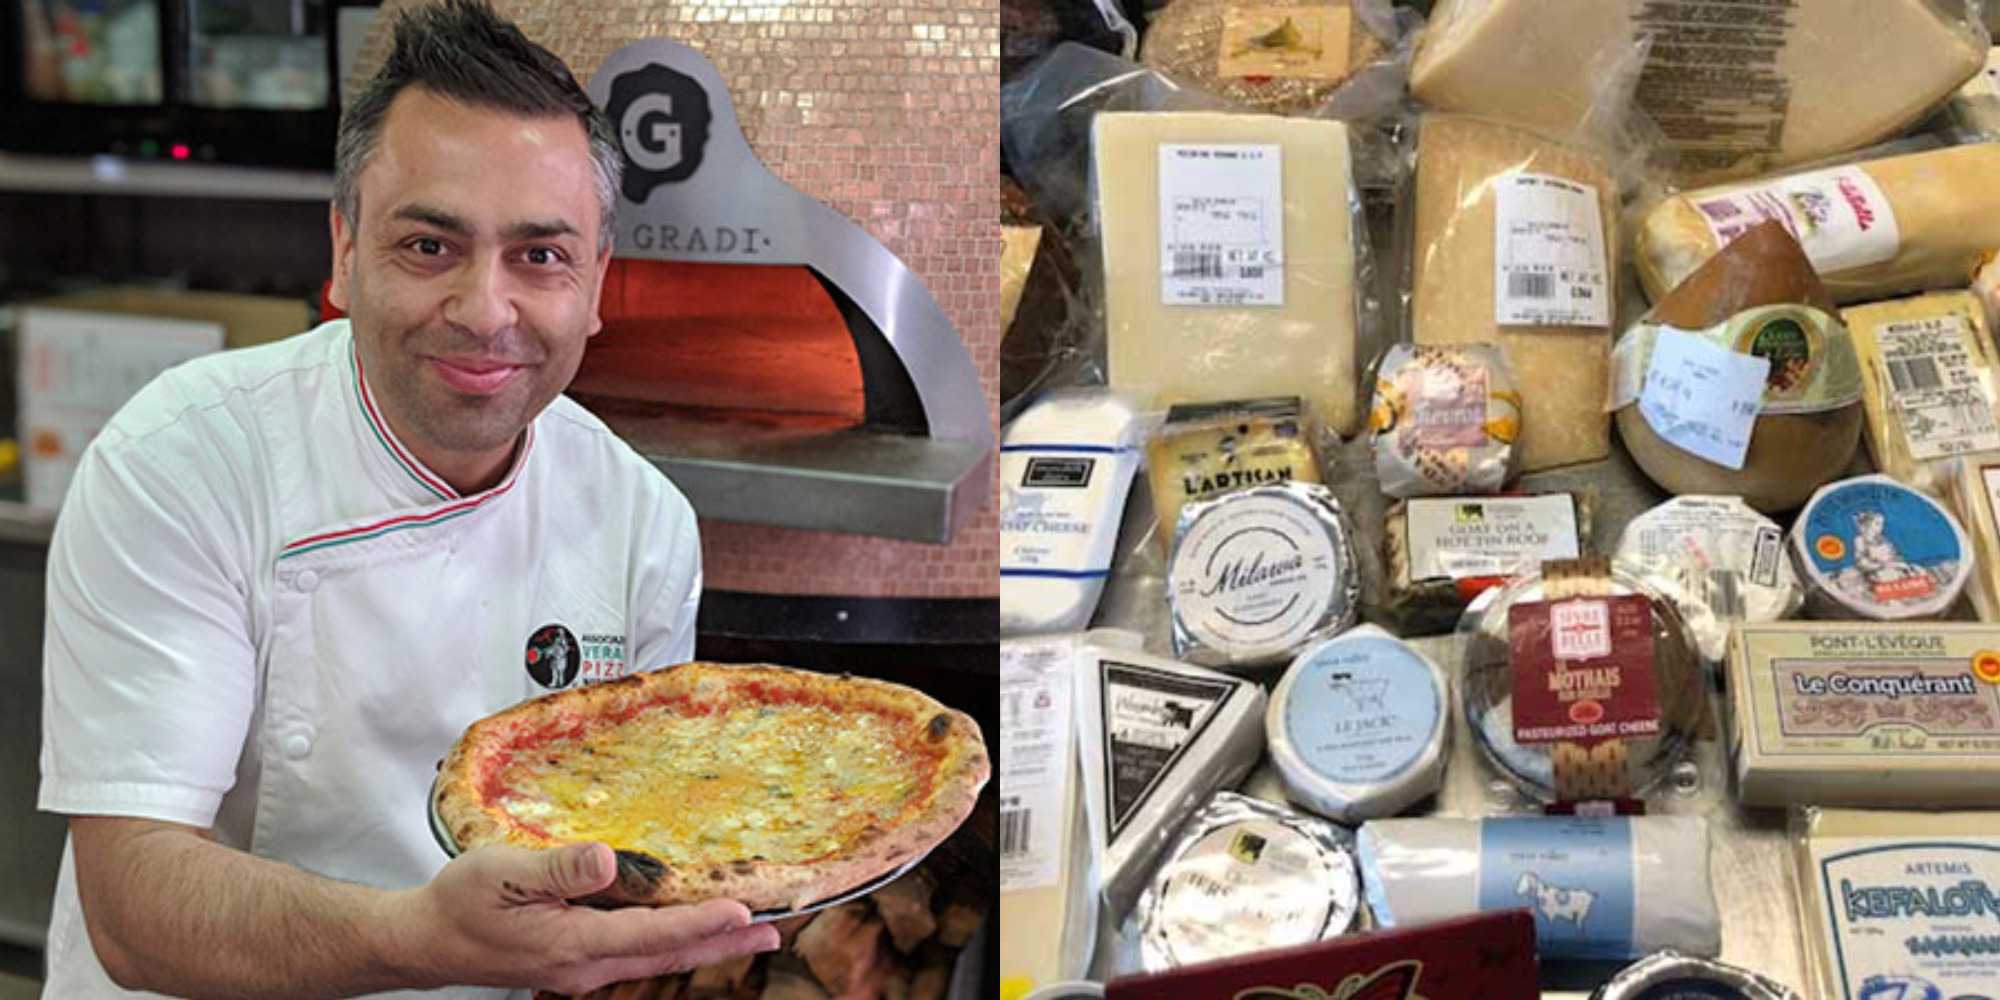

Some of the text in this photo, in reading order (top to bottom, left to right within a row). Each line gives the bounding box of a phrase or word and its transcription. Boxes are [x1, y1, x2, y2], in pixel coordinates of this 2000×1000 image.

[620, 92, 682, 171] G
[583, 645, 624, 660] VERA
[1792, 670, 1978, 700] Le Conquérant
[1905, 862, 1973, 875] ARTEMIS
